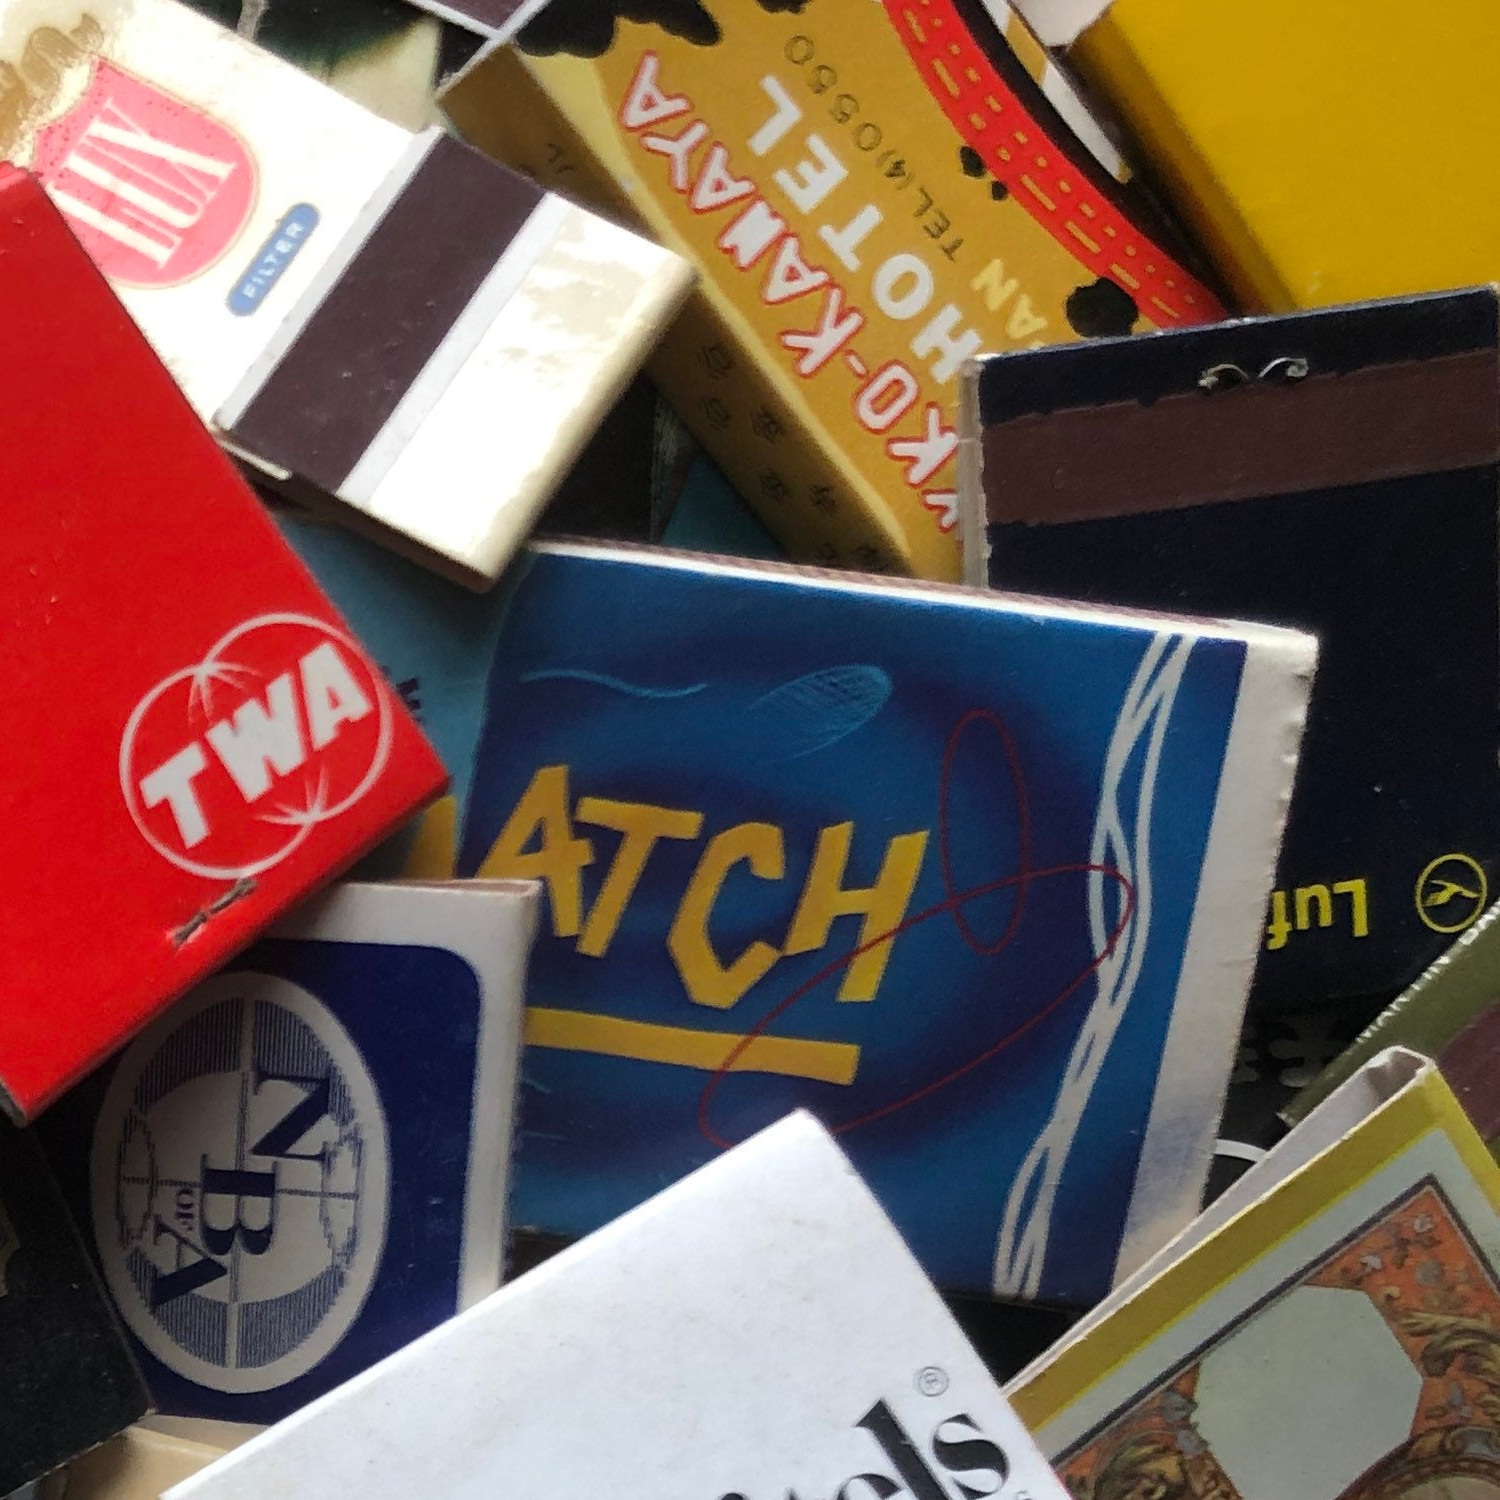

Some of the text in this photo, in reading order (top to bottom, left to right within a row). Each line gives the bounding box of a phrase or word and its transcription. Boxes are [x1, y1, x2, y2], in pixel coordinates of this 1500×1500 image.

[45, 97, 235, 270] LUX
[242, 219, 307, 300] FILTER
[747, 74, 983, 385] HOTEL
[970, 257, 1051, 347] AN
[140, 643, 371, 849] TWA
[407, 765, 930, 1010] ATCH
